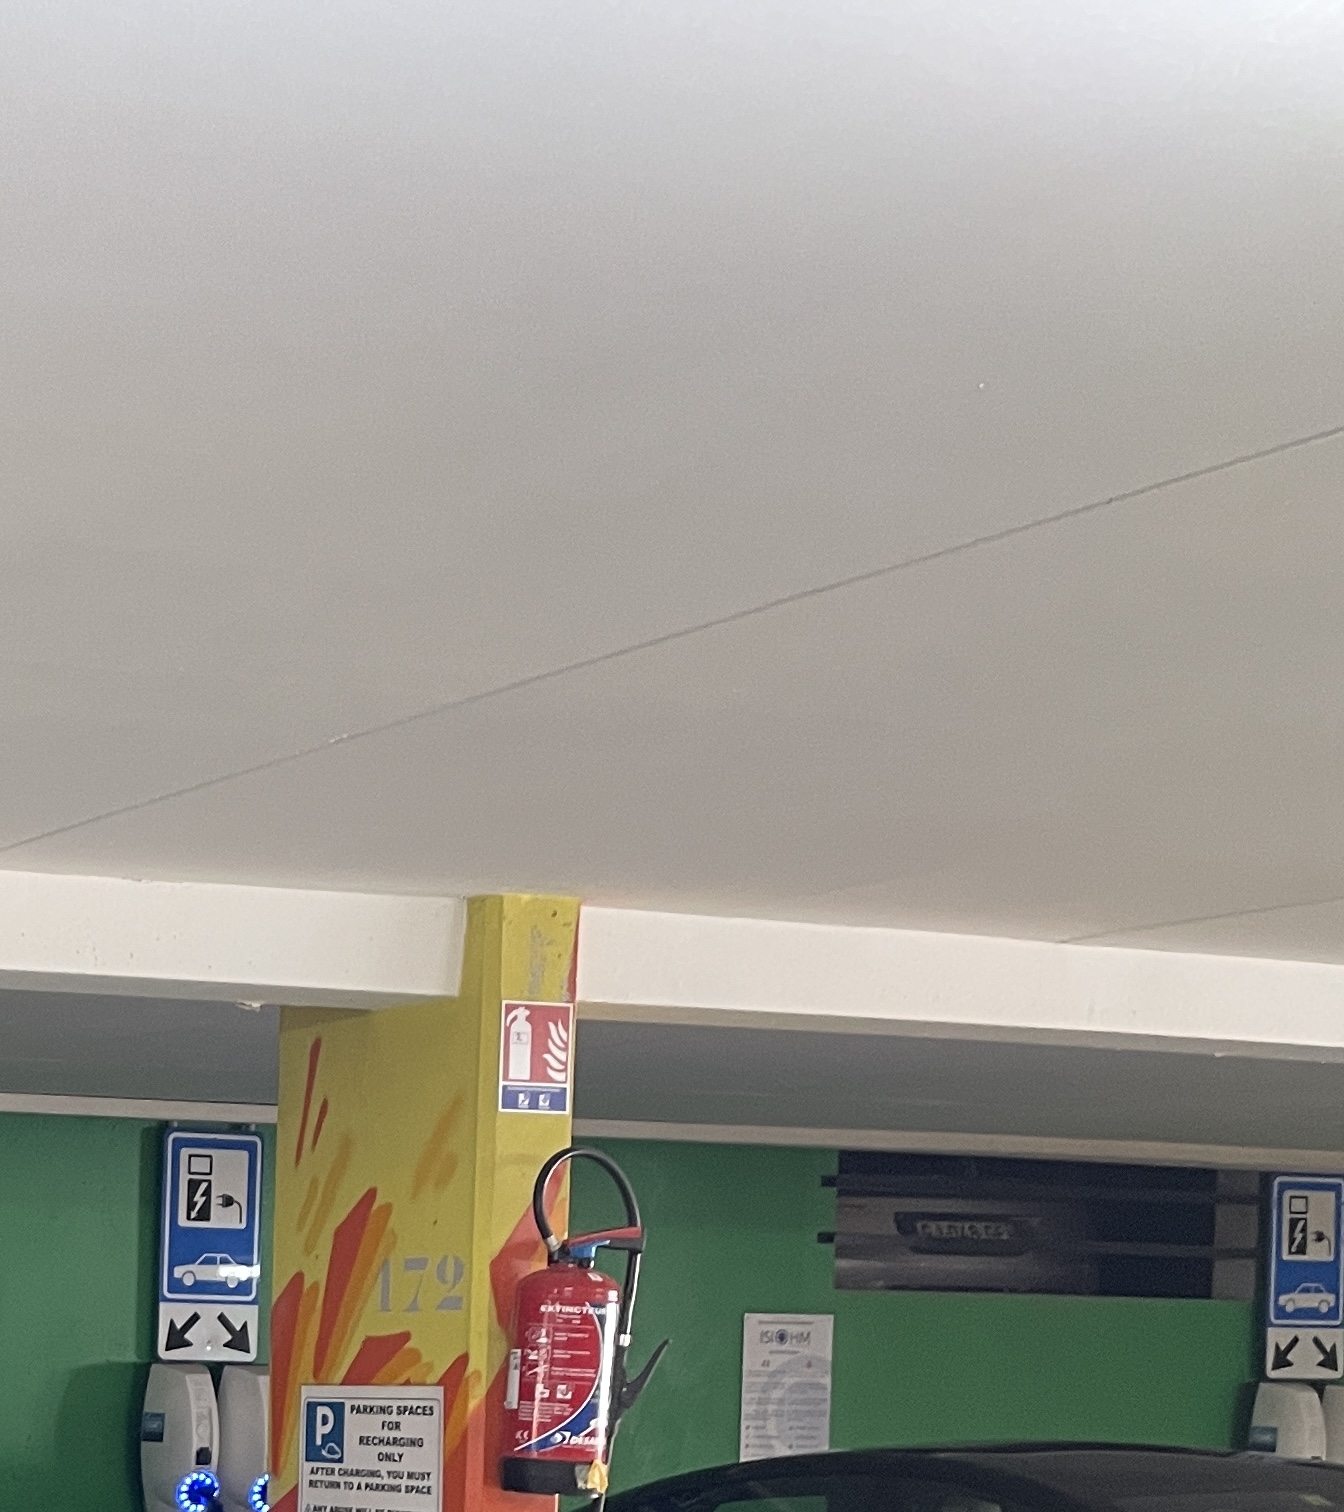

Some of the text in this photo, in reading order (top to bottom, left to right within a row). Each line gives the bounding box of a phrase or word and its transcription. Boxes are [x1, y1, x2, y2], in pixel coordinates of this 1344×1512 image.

[379, 1253, 465, 1313] 172
[350, 1404, 434, 1416] PARKING SPACES
[315, 1405, 335, 1446] P
[381, 1420, 401, 1431] FOR
[359, 1436, 424, 1447] RECHARGING
[377, 1452, 404, 1463] ONLY
[309, 1467, 336, 1477] AFTER
[386, 1470, 404, 1480] YOU
[406, 1470, 432, 1481] MUST
[308, 1479, 432, 1495] RETURN TO A PARKING SPACE
[312, 1504, 328, 1512] ANY
